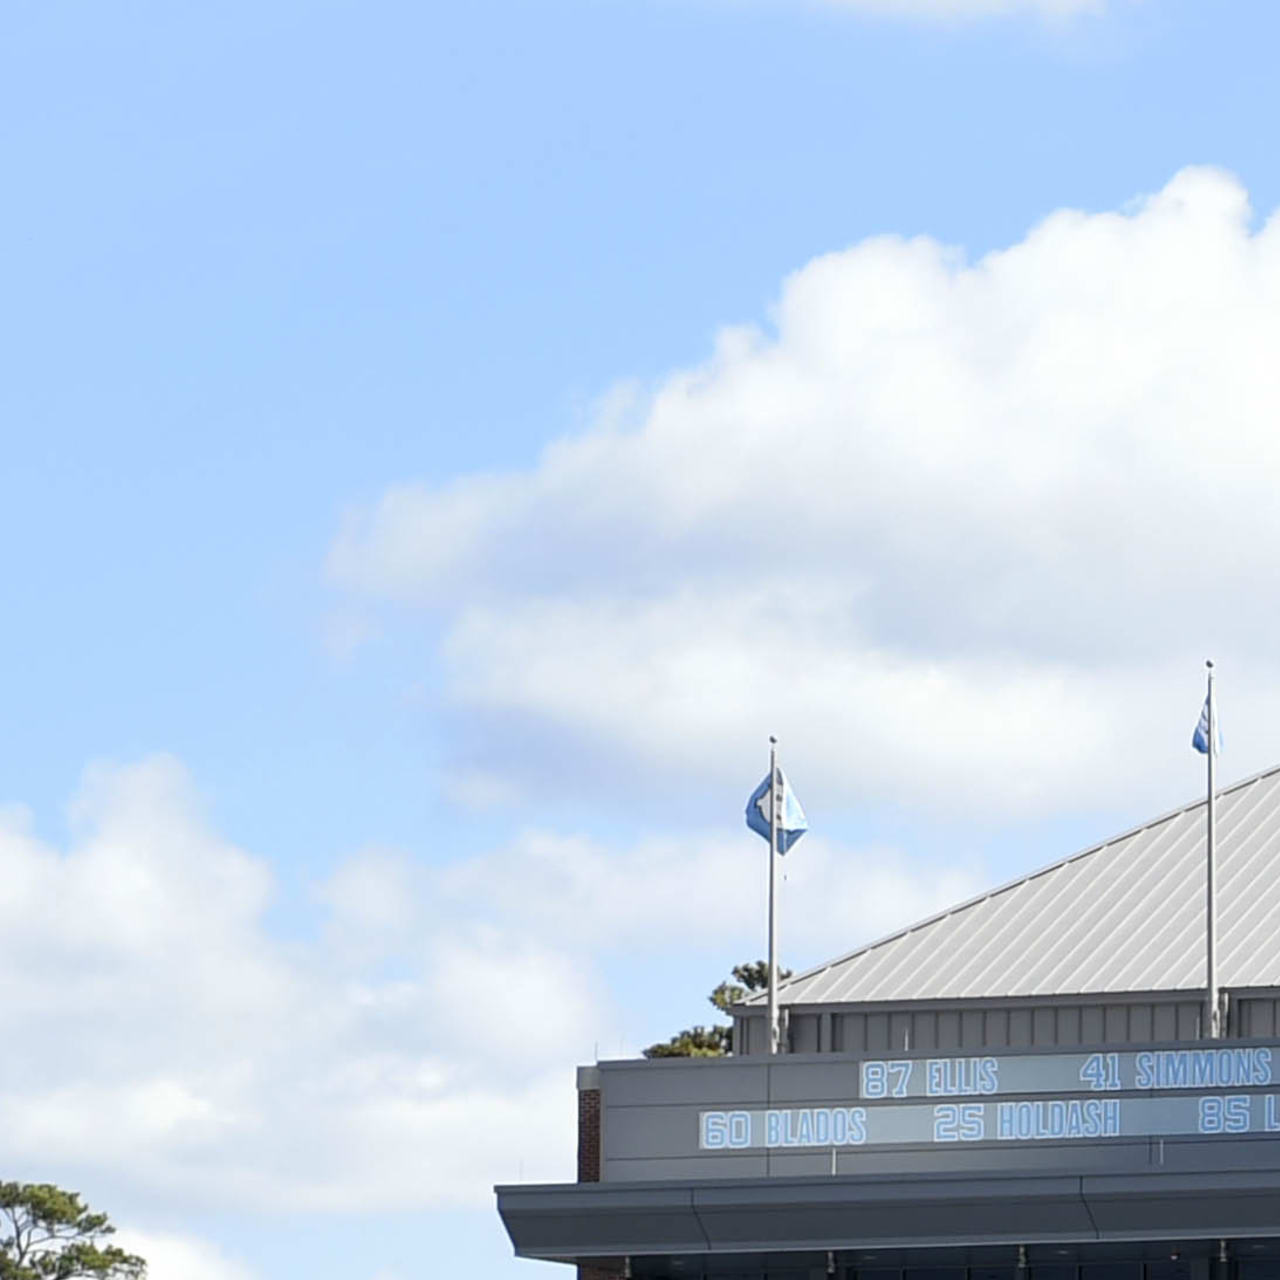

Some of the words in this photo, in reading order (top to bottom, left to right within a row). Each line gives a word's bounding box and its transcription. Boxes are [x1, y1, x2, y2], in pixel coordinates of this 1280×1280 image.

[861, 1060, 912, 1099] 87
[926, 1056, 999, 1097] ELLIS
[1079, 1052, 1121, 1093] 41
[1135, 1047, 1272, 1090] SIMMONS
[702, 1110, 752, 1150] 60
[765, 1106, 867, 1149] BLADOS
[933, 1103, 985, 1142] 25
[999, 1099, 1120, 1140] HOLDASH
[1199, 1095, 1251, 1135] 85
